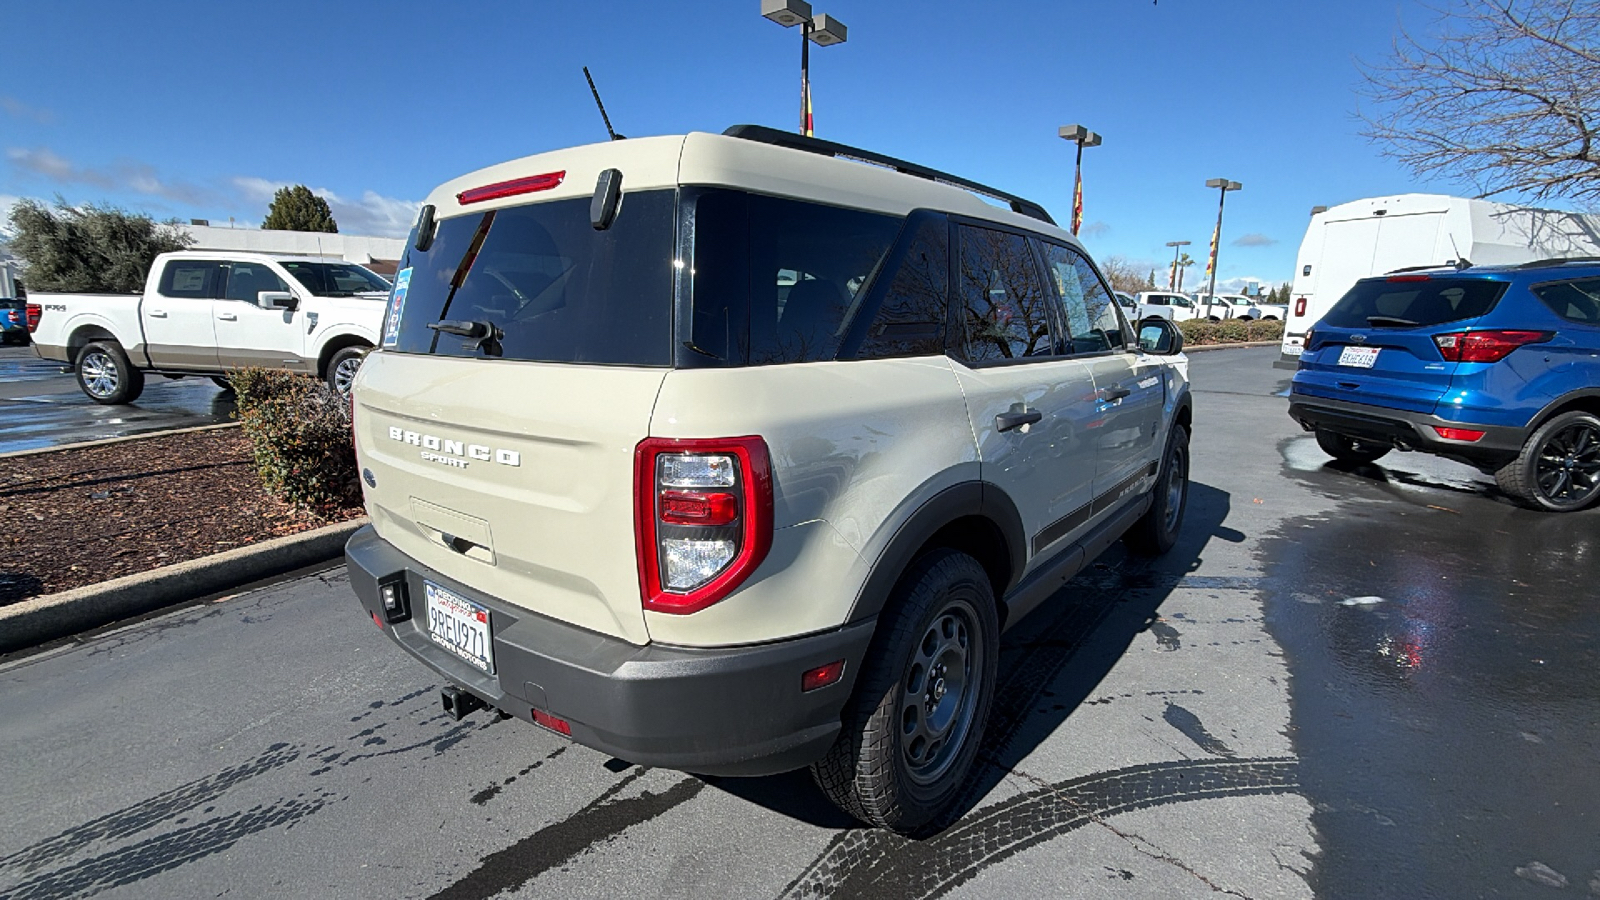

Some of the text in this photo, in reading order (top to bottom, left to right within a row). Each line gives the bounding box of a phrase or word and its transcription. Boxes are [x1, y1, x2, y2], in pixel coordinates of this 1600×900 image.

[45, 304, 67, 312] FX4
[389, 426, 520, 467] BRONCO
[420, 451, 469, 469] SPORT
[431, 606, 487, 661] 9REU971
[457, 646, 488, 671] MOTORS
